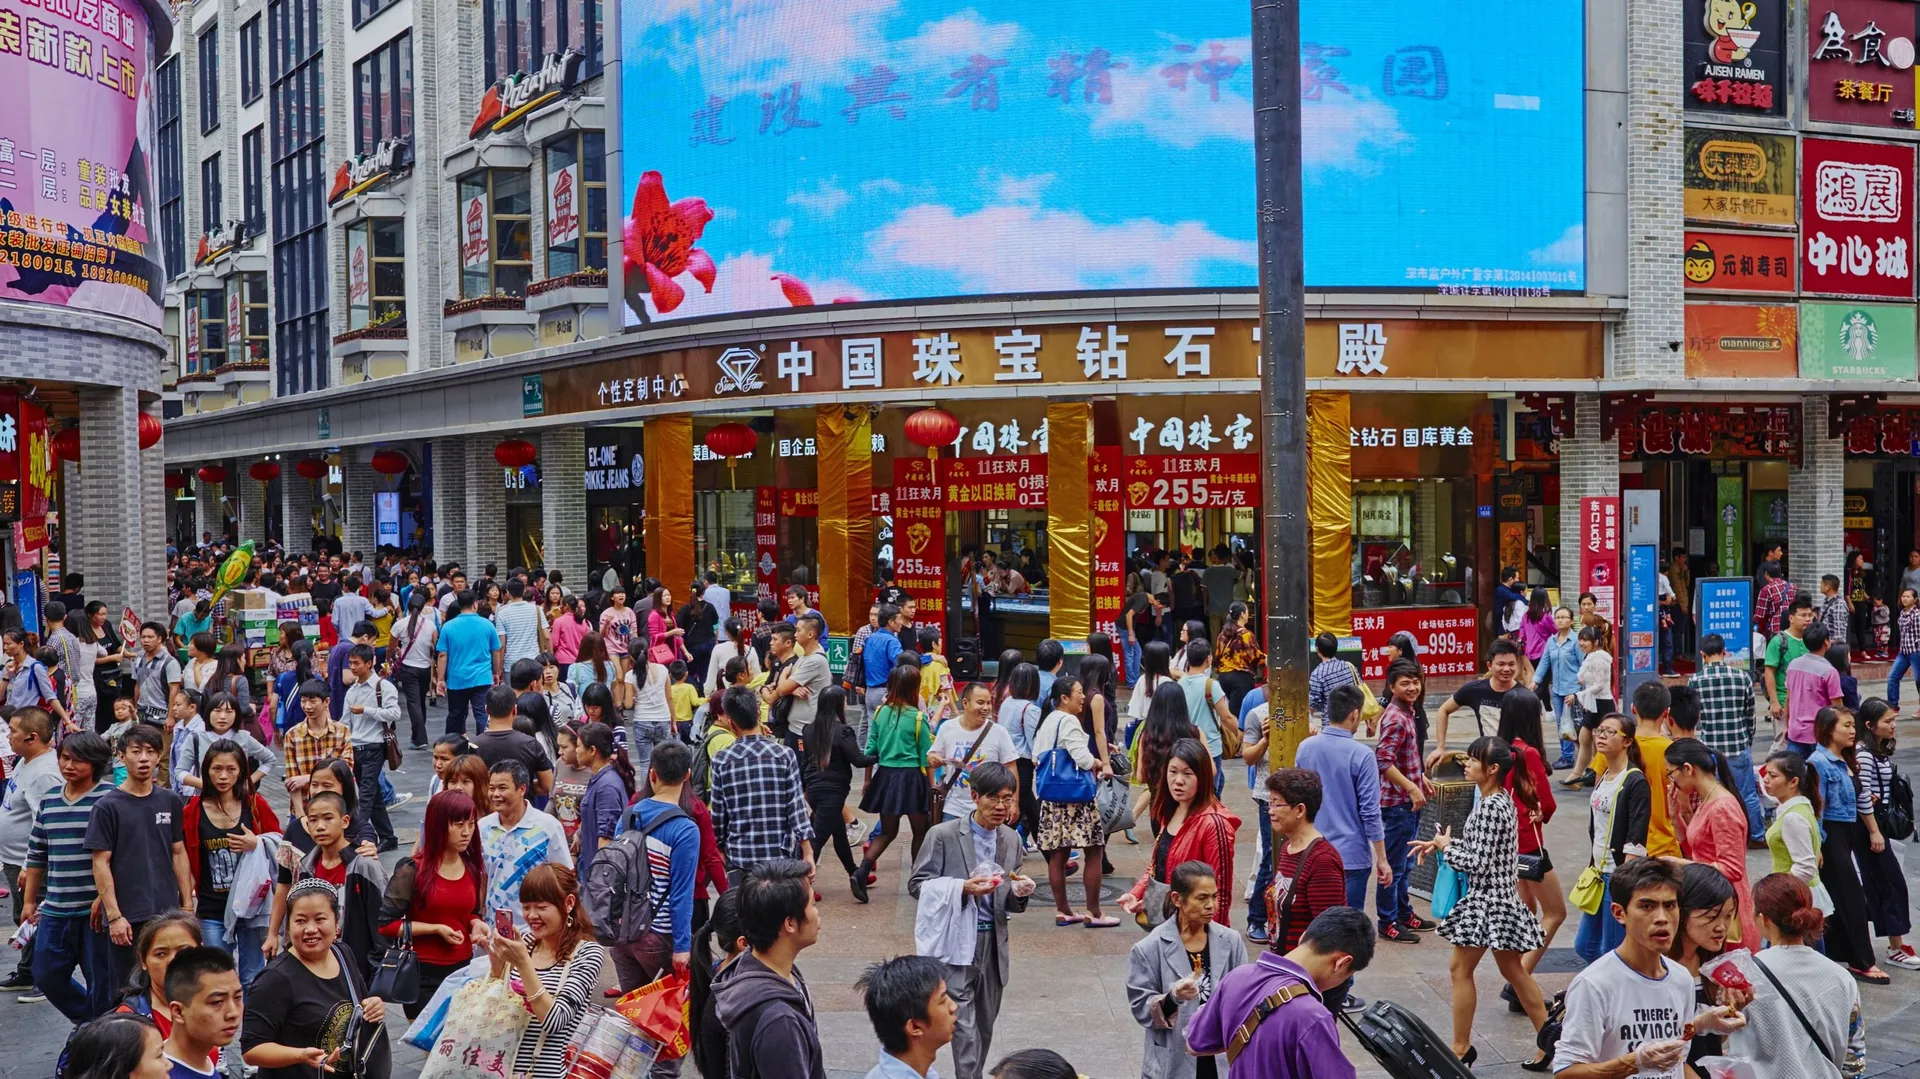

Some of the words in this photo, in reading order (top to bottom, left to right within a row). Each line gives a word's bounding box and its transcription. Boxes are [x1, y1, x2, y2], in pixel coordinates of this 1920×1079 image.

[500, 72, 541, 119] Pizza
[538, 49, 576, 93] Hut
[1705, 64, 1734, 78] AJISEN
[1734, 67, 1765, 81] RAMEN
[1838, 79, 1893, 102] 茶餐厅
[1702, 195, 1768, 216] 大家乐餐厅
[1722, 254, 1789, 278] 元和寿司
[1807, 231, 1910, 280] 中心城
[1720, 337, 1771, 350] mannings
[777, 323, 1389, 393] 中国珠宝钻石殿
[1831, 365, 1888, 375] STARBUCKS
[597, 373, 687, 406] 个性定制中心
[1129, 413, 1254, 456] 中国珠宝
[1402, 425, 1474, 448] 国库黄金
[605, 467, 630, 490] JEANS
[947, 482, 1017, 503] 黄金以旧换新
[896, 557, 943, 576] 255元/克
